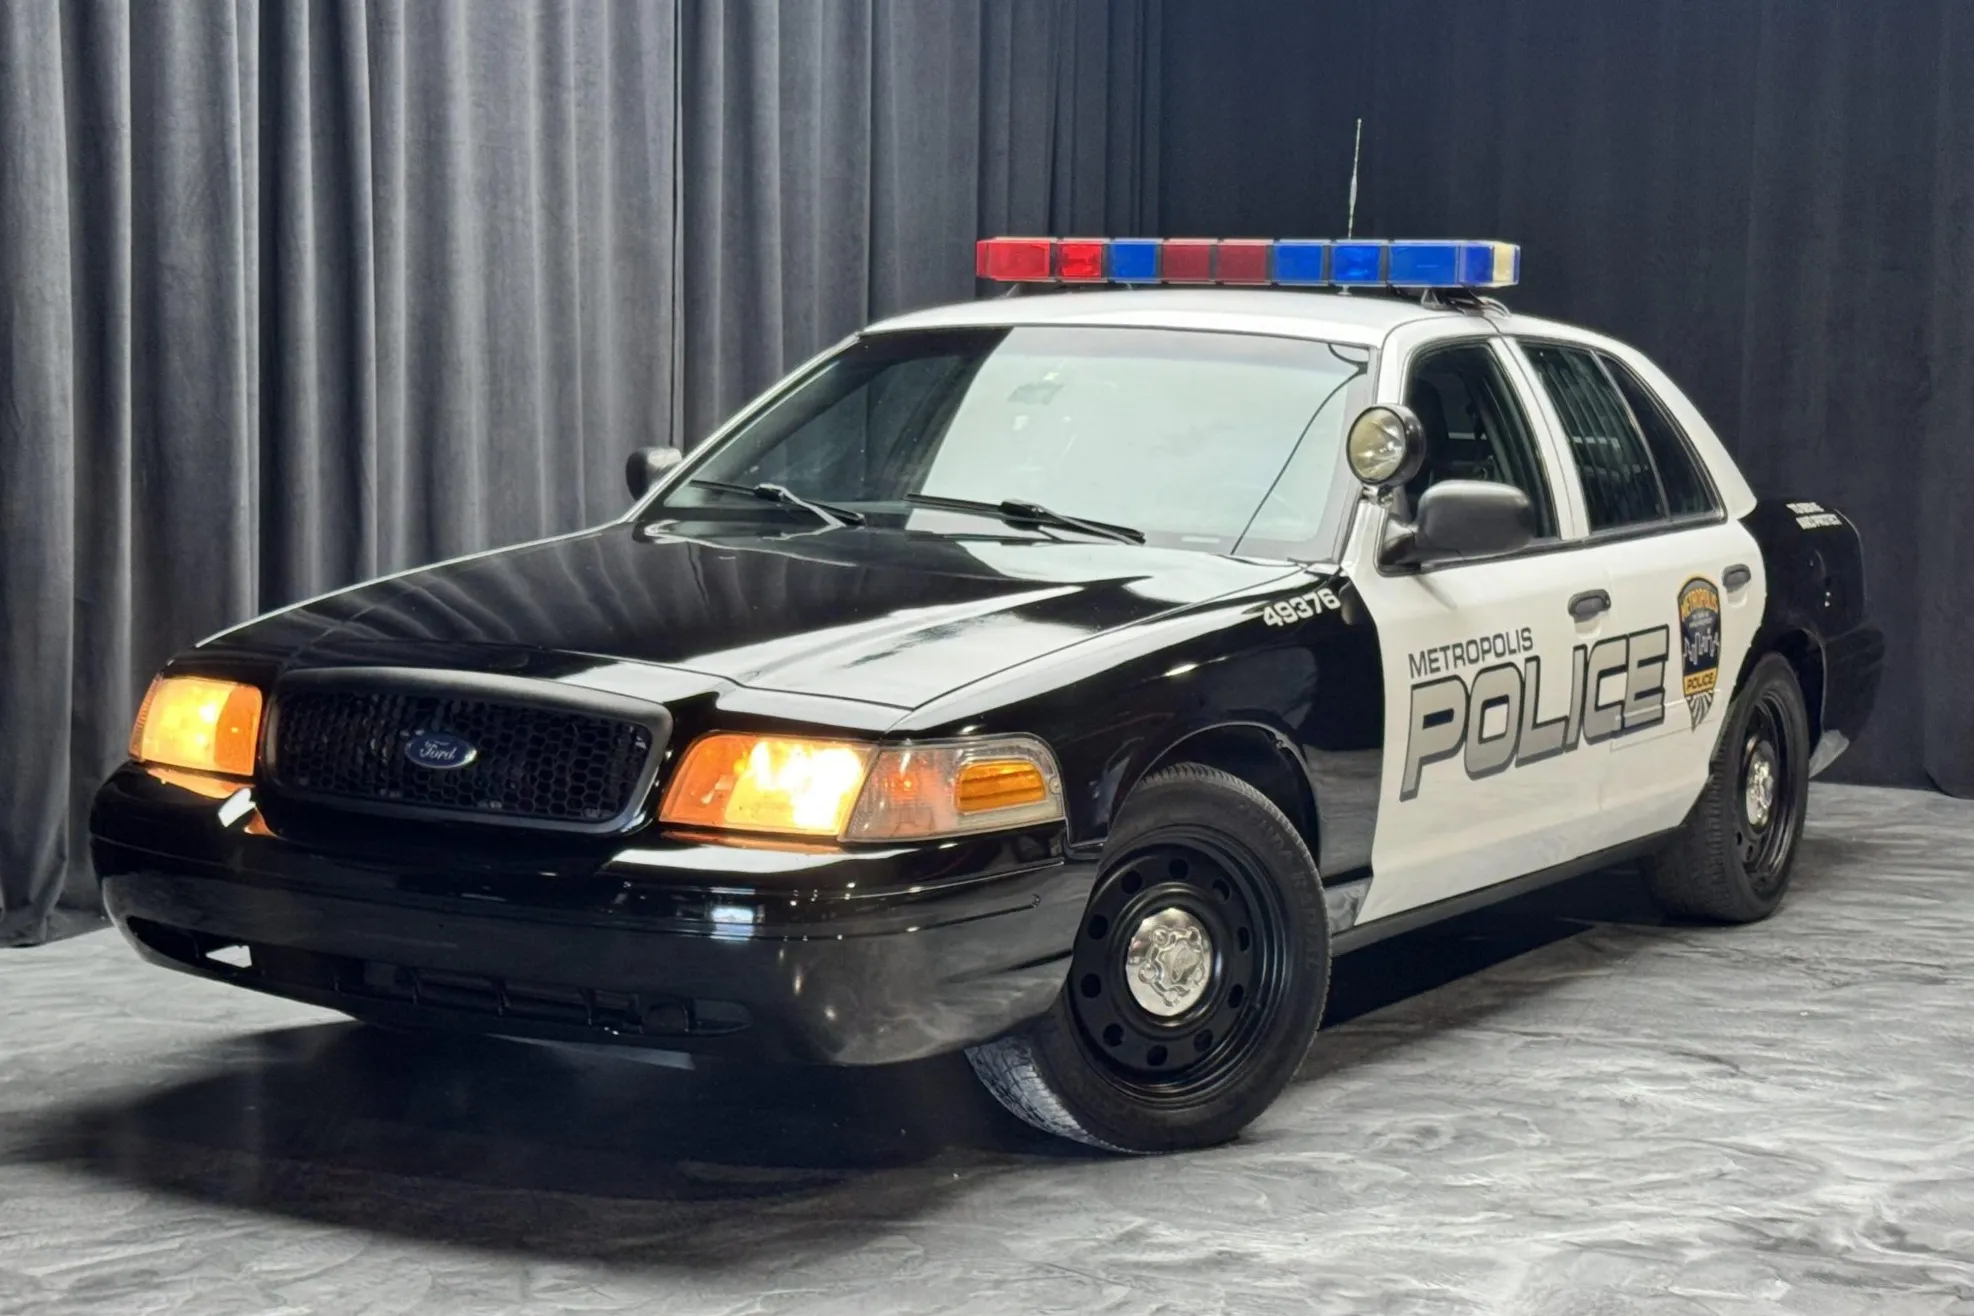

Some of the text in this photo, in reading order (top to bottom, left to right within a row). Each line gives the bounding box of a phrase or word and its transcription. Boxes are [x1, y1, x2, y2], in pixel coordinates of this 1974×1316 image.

[1263, 588, 1341, 627] 49376
[1408, 627, 1533, 679] METROPOLIS
[1686, 672, 1714, 691] POLICE
[1400, 624, 1669, 802] POLICE
[419, 740, 458, 760] Ford
